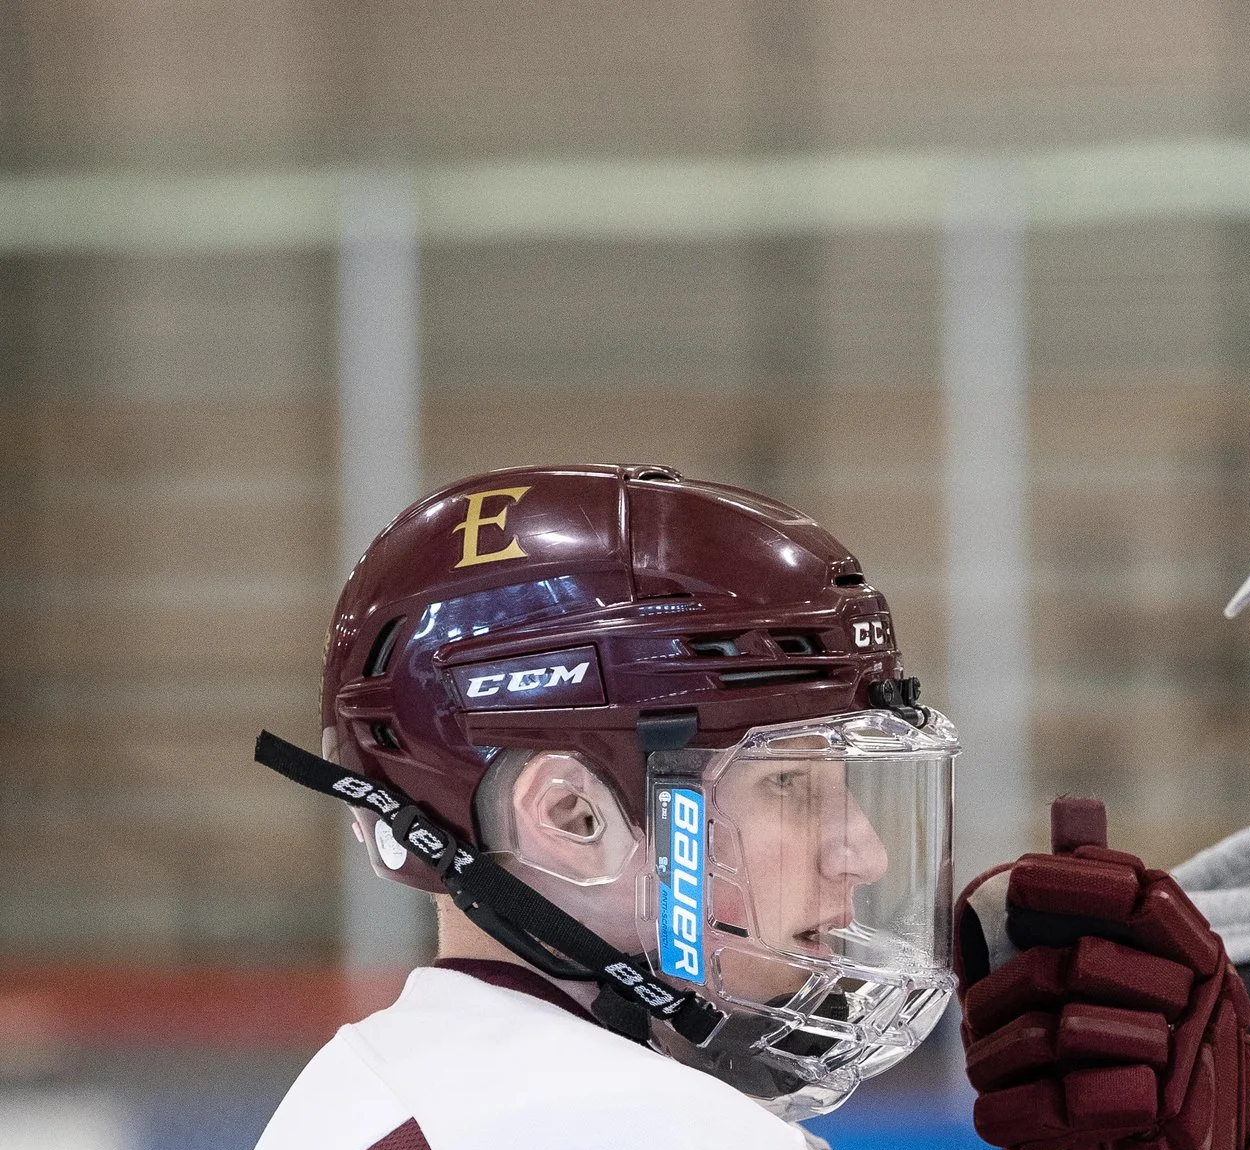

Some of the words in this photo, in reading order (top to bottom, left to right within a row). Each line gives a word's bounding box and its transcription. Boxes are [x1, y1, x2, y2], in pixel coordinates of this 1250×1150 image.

[452, 486, 532, 569] E
[853, 621, 891, 647] CC
[466, 662, 590, 698] CCM
